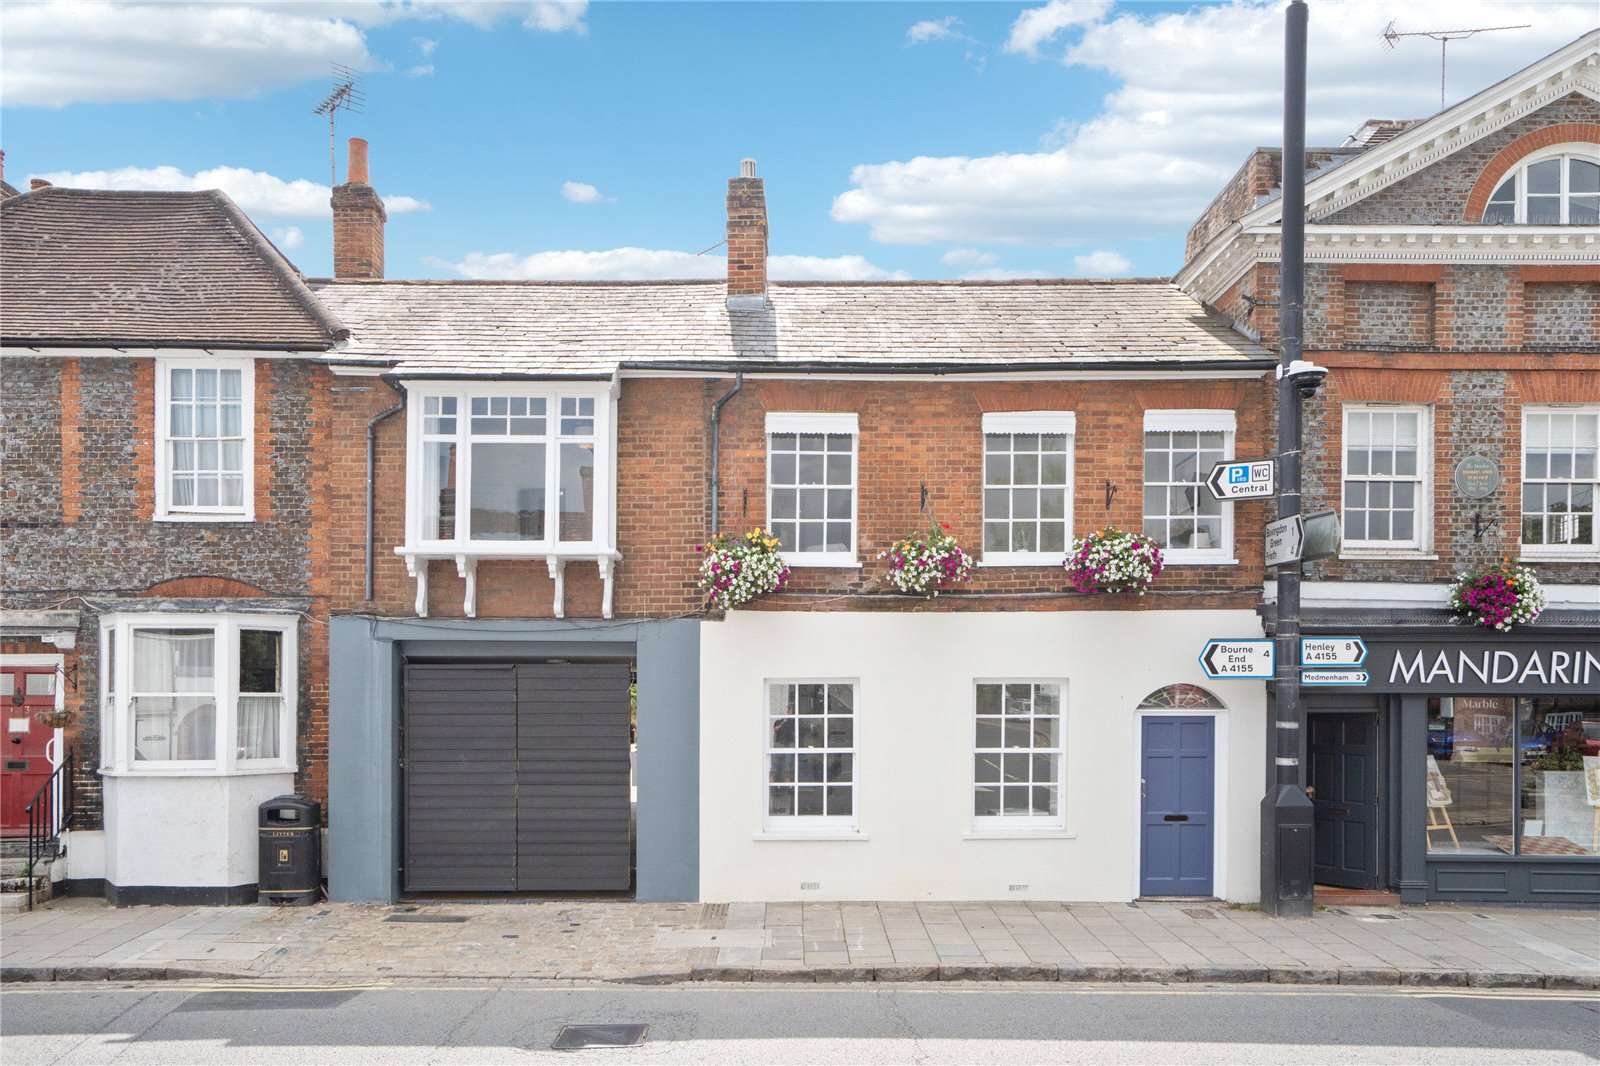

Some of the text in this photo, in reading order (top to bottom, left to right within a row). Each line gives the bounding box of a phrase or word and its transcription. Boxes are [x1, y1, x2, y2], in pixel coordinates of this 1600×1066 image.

[1231, 468, 1268, 483] P WC
[1231, 484, 1268, 494] Central
[1220, 645, 1254, 654] Bourne
[1305, 643, 1352, 652] Henley 8
[1228, 655, 1246, 663] End
[1306, 652, 1337, 660] A 4155
[1463, 699, 1498, 709] Marble
